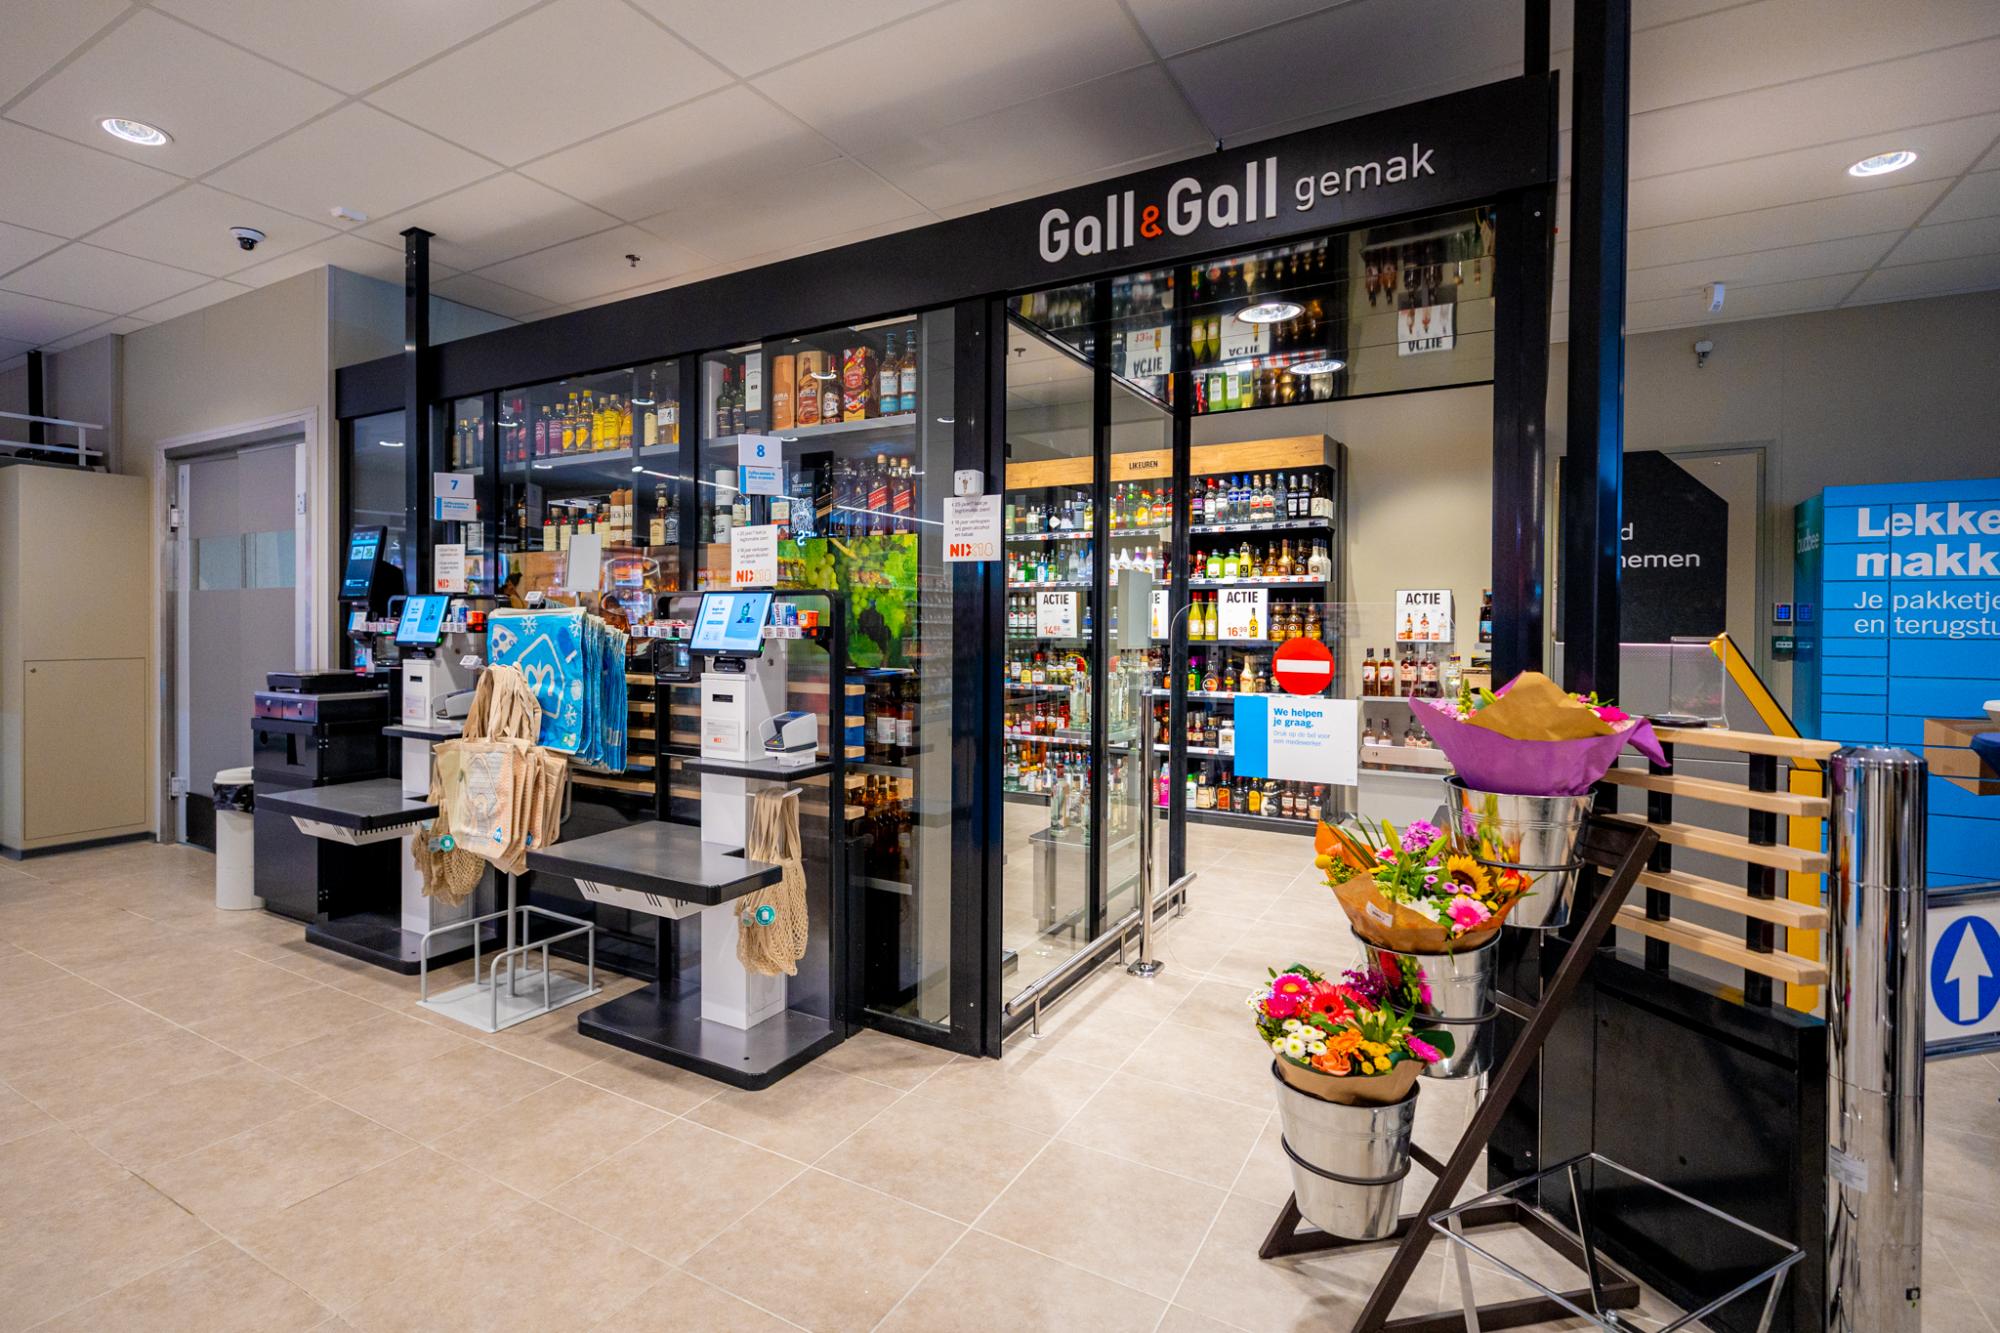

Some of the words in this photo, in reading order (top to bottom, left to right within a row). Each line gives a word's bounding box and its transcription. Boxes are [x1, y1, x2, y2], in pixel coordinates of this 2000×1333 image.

[1295, 143, 1435, 211] gemak
[756, 444, 766, 458] 8
[1129, 460, 1158, 470] LIKEUREN
[450, 480, 459, 490] 7
[1043, 594, 1069, 605] ACTIE
[1226, 591, 1258, 603] ACTIE
[1406, 592, 1441, 605] ACTIE
[1854, 591, 1883, 609] Je
[1854, 618, 1885, 633] en
[1273, 708, 1288, 717] We
[1291, 708, 1323, 719] helpen
[1273, 717, 1282, 727] je
